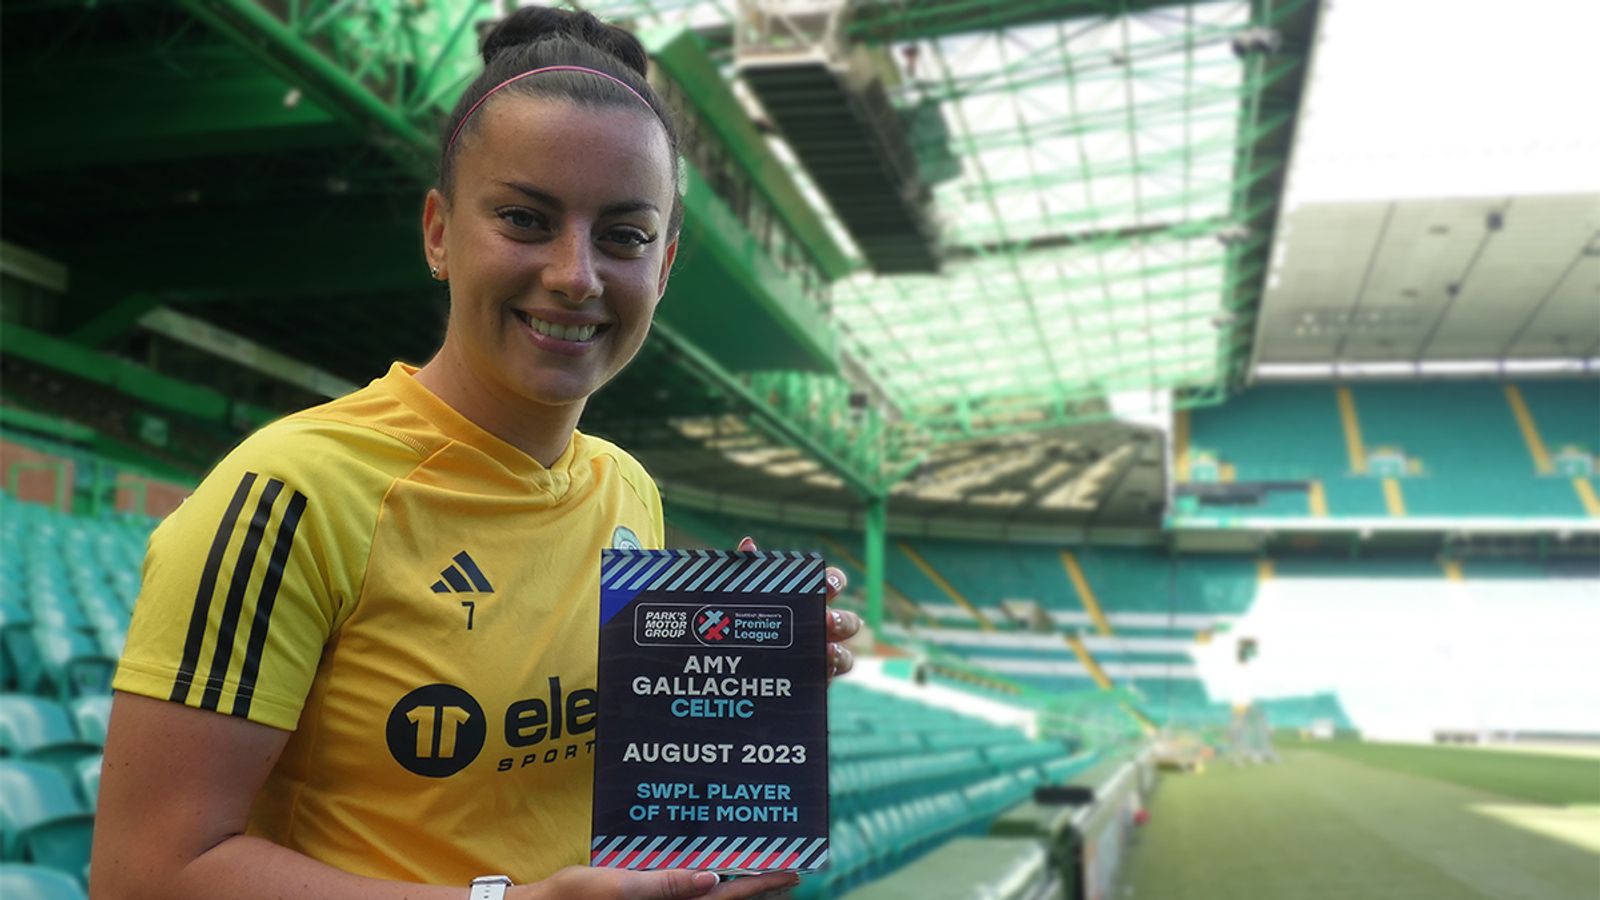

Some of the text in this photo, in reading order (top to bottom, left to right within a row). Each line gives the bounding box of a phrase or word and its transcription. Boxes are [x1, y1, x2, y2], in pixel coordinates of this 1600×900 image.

[461, 601, 475, 630] 7
[645, 611, 687, 620] PARK'S
[645, 620, 688, 629] MOTOR
[734, 618, 782, 629] Premier
[644, 629, 686, 638] GROUP
[734, 629, 779, 642] League
[683, 655, 742, 674] AMY
[631, 676, 792, 697] GALLACHER
[670, 699, 755, 719] CELTIC
[622, 742, 807, 764] AUGUST 2023
[636, 782, 791, 800] SWPL PLAYER
[629, 804, 798, 823] OF THE MONTH
